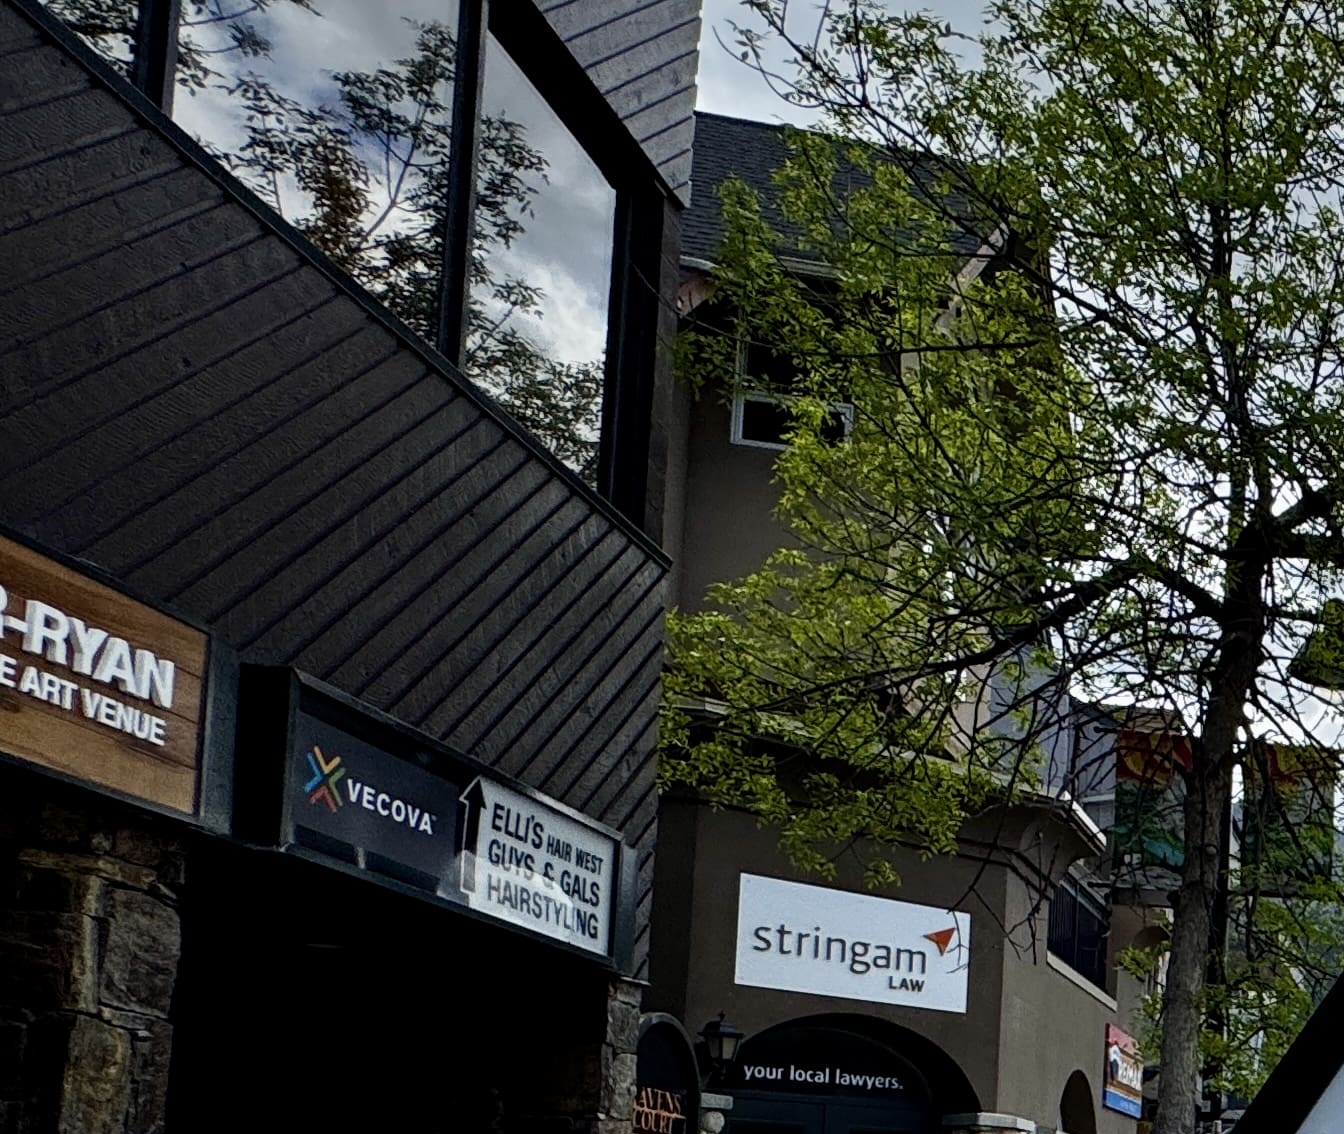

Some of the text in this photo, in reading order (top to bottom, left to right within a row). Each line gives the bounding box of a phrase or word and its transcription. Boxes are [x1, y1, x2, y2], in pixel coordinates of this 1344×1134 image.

[0, 584, 175, 709] -RYAN
[18, 666, 79, 710] ART
[80, 687, 168, 747] VENUE
[347, 778, 433, 835] VECOVA
[491, 802, 604, 875] ELLI'S HAIR WEST
[488, 838, 535, 881] GUYS
[560, 869, 600, 907] GALS
[487, 873, 599, 940] HAIRSTYLING
[752, 924, 926, 974] stringam
[888, 975, 925, 992] LAW
[633, 1087, 682, 1115] AVENS
[743, 1064, 904, 1089] your local lawyers.
[632, 1110, 673, 1134] COURT
